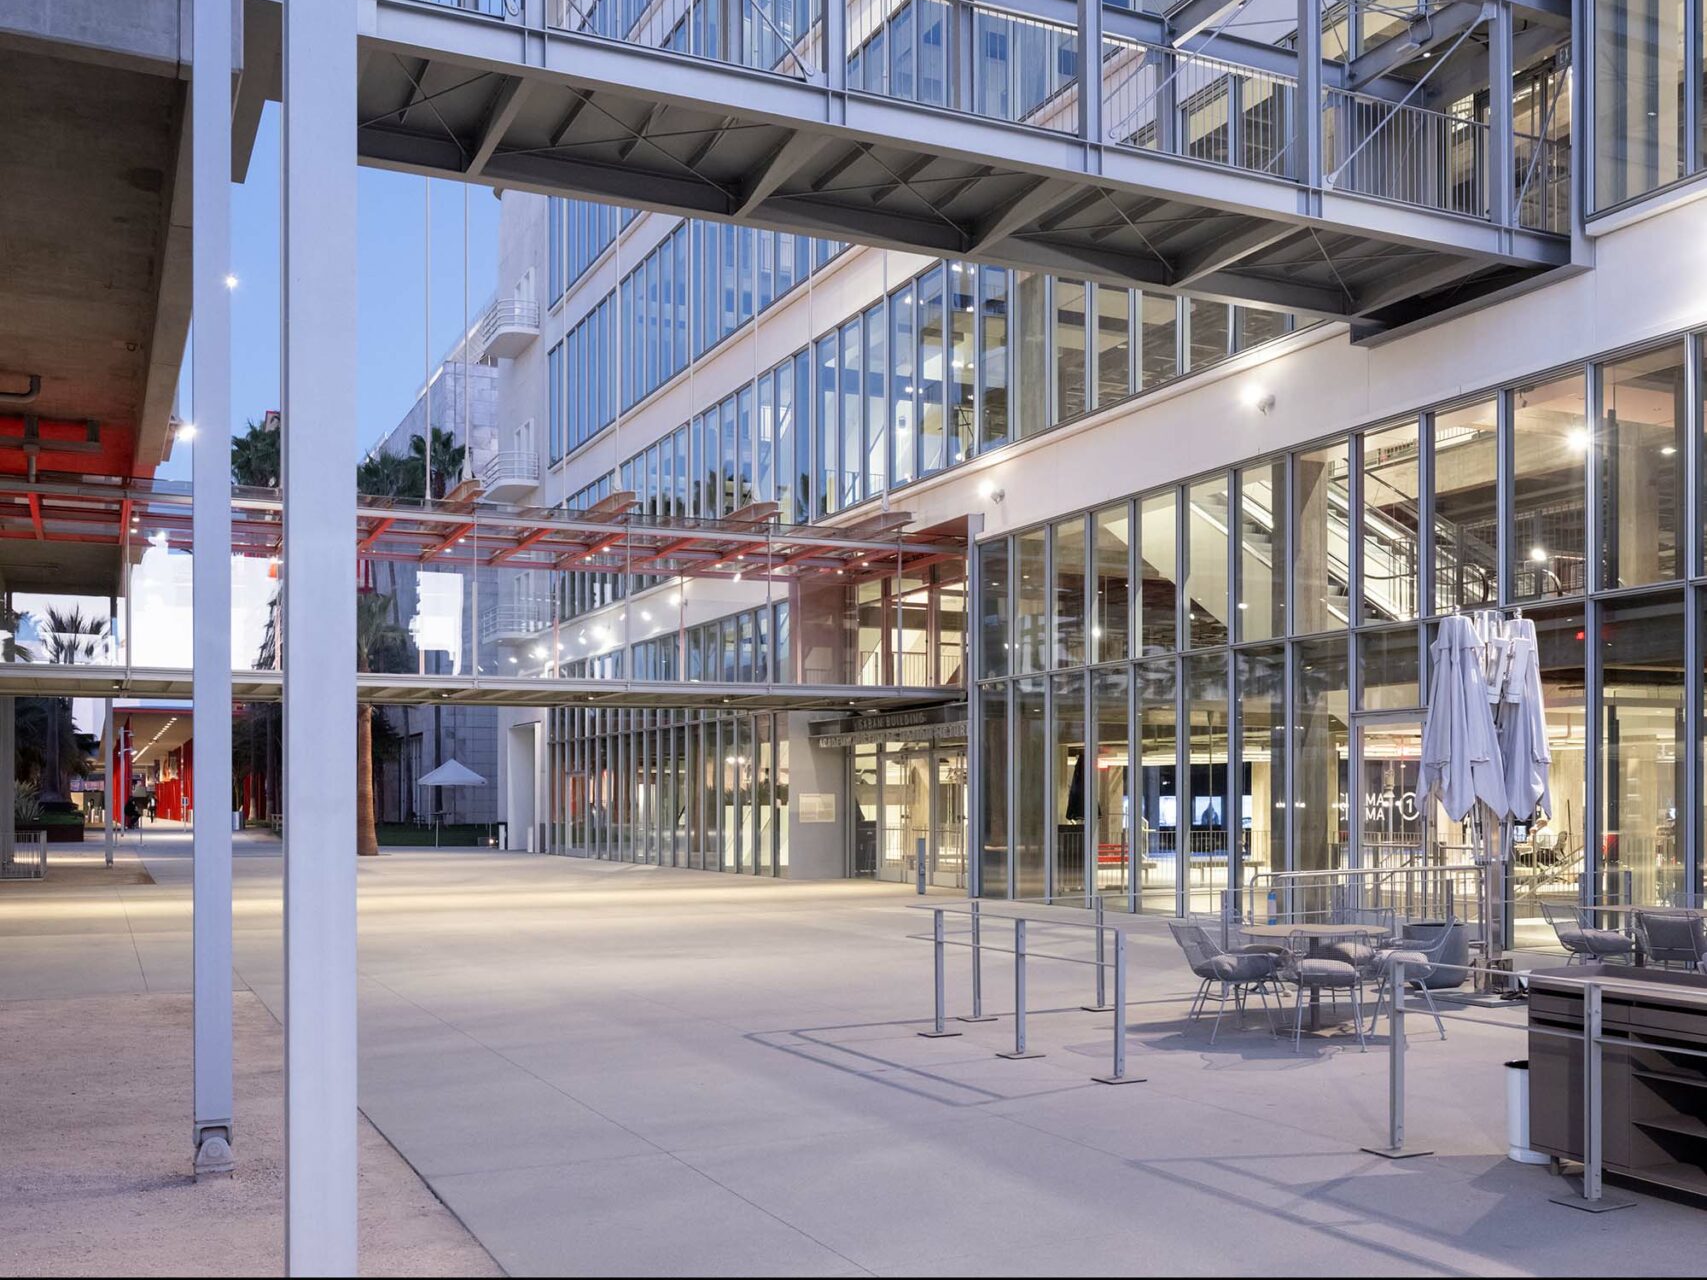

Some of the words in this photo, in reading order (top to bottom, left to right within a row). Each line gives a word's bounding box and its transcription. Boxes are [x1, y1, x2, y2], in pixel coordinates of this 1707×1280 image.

[885, 712, 925, 727] BUILDING
[1340, 792, 1384, 807] CIMA
[1406, 798, 1413, 813] 1
[1340, 807, 1385, 821] CIMA
